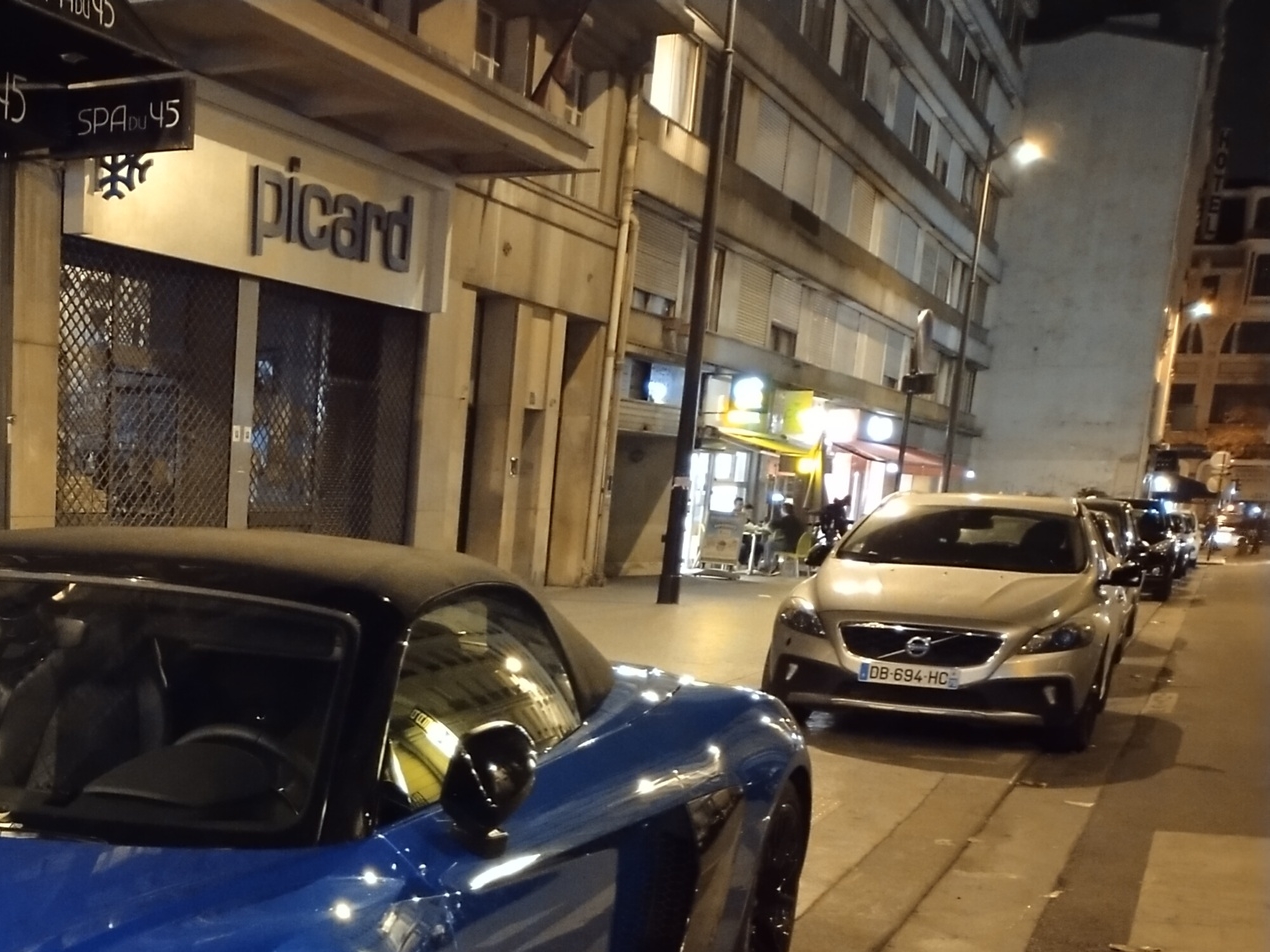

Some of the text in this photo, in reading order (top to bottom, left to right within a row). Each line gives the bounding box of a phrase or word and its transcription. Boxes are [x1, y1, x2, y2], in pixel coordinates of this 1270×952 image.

[77, 98, 181, 136] SPA DU 45
[249, 155, 415, 273] picard
[869, 664, 950, 686] DB-694-HC
